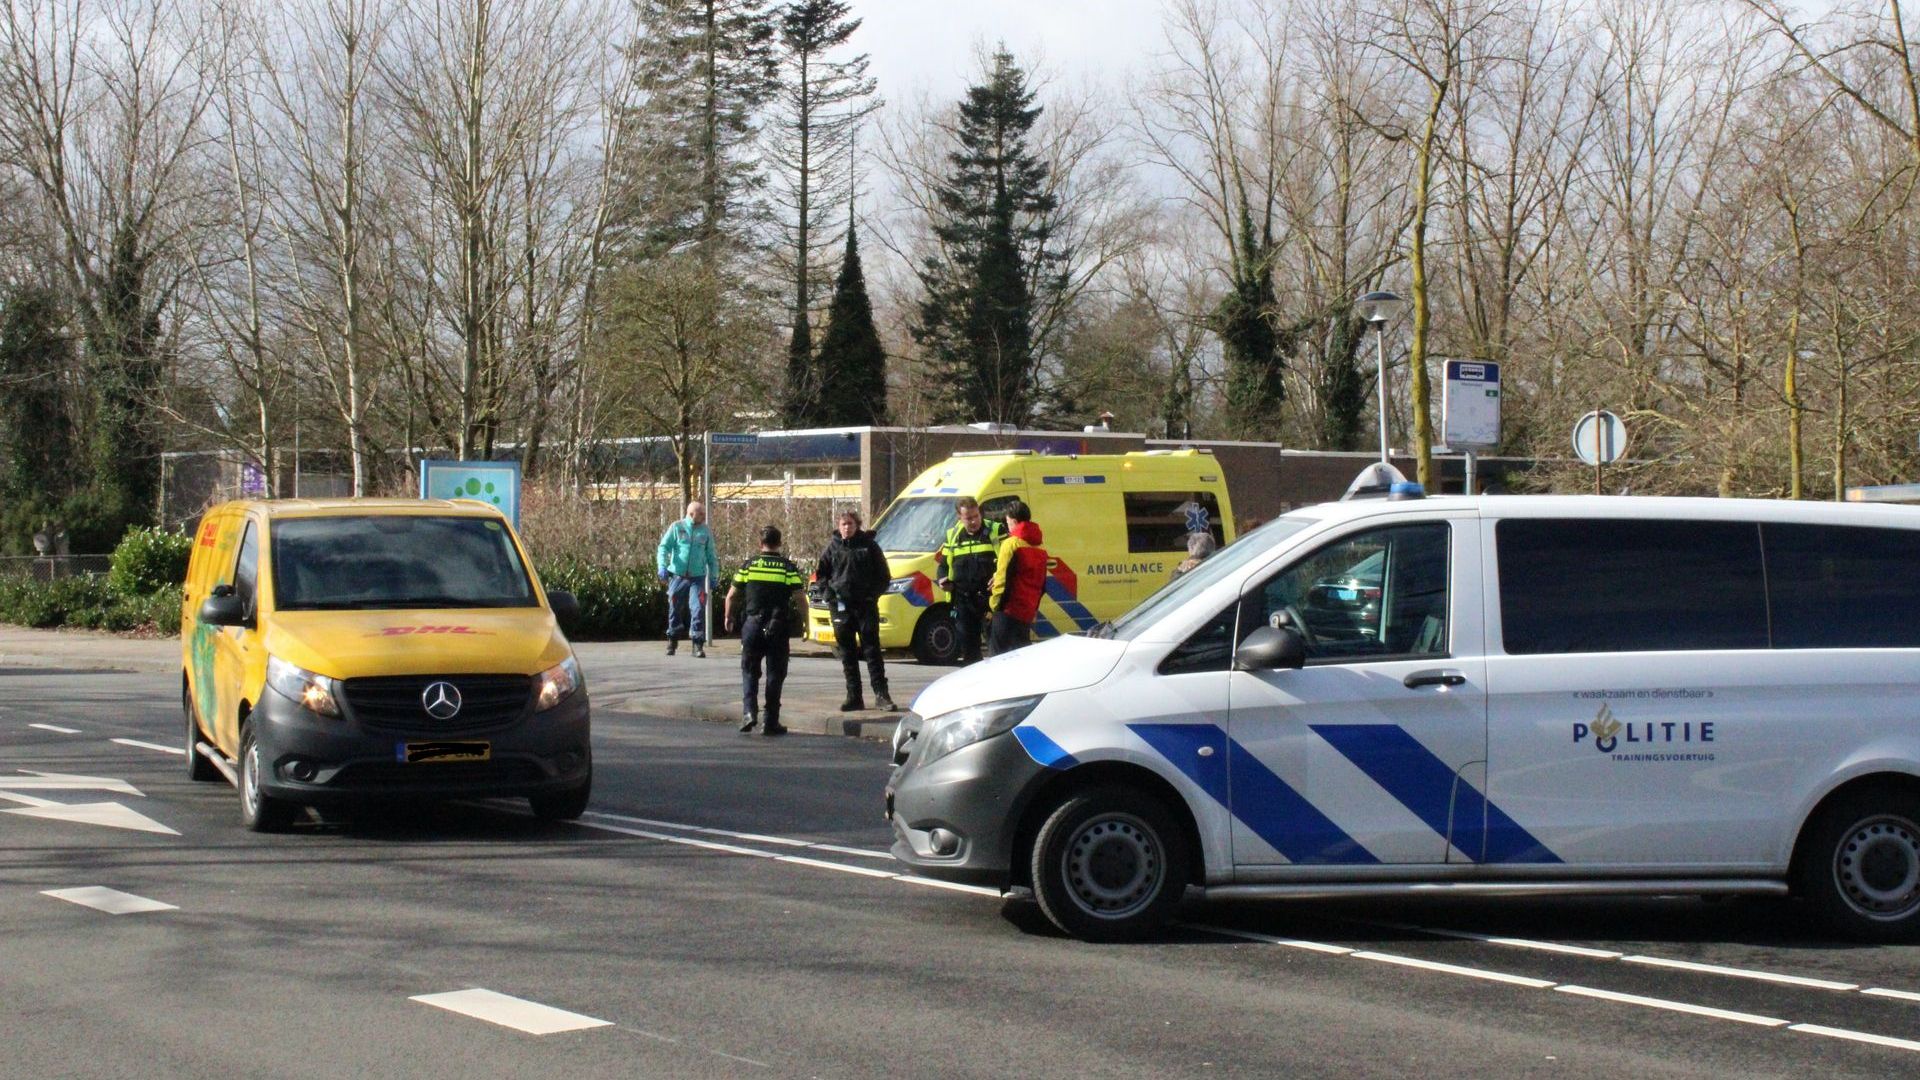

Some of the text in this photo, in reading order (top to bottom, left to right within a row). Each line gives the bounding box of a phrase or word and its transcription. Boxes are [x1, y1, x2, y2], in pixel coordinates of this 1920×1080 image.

[1087, 562, 1164, 575] AMBULANCE
[382, 626, 478, 636] DHL
[1637, 690, 1650, 699] en
[1573, 722, 1714, 753] POLITIE
[1611, 754, 1715, 762] TRAININGSVOERTUIG
